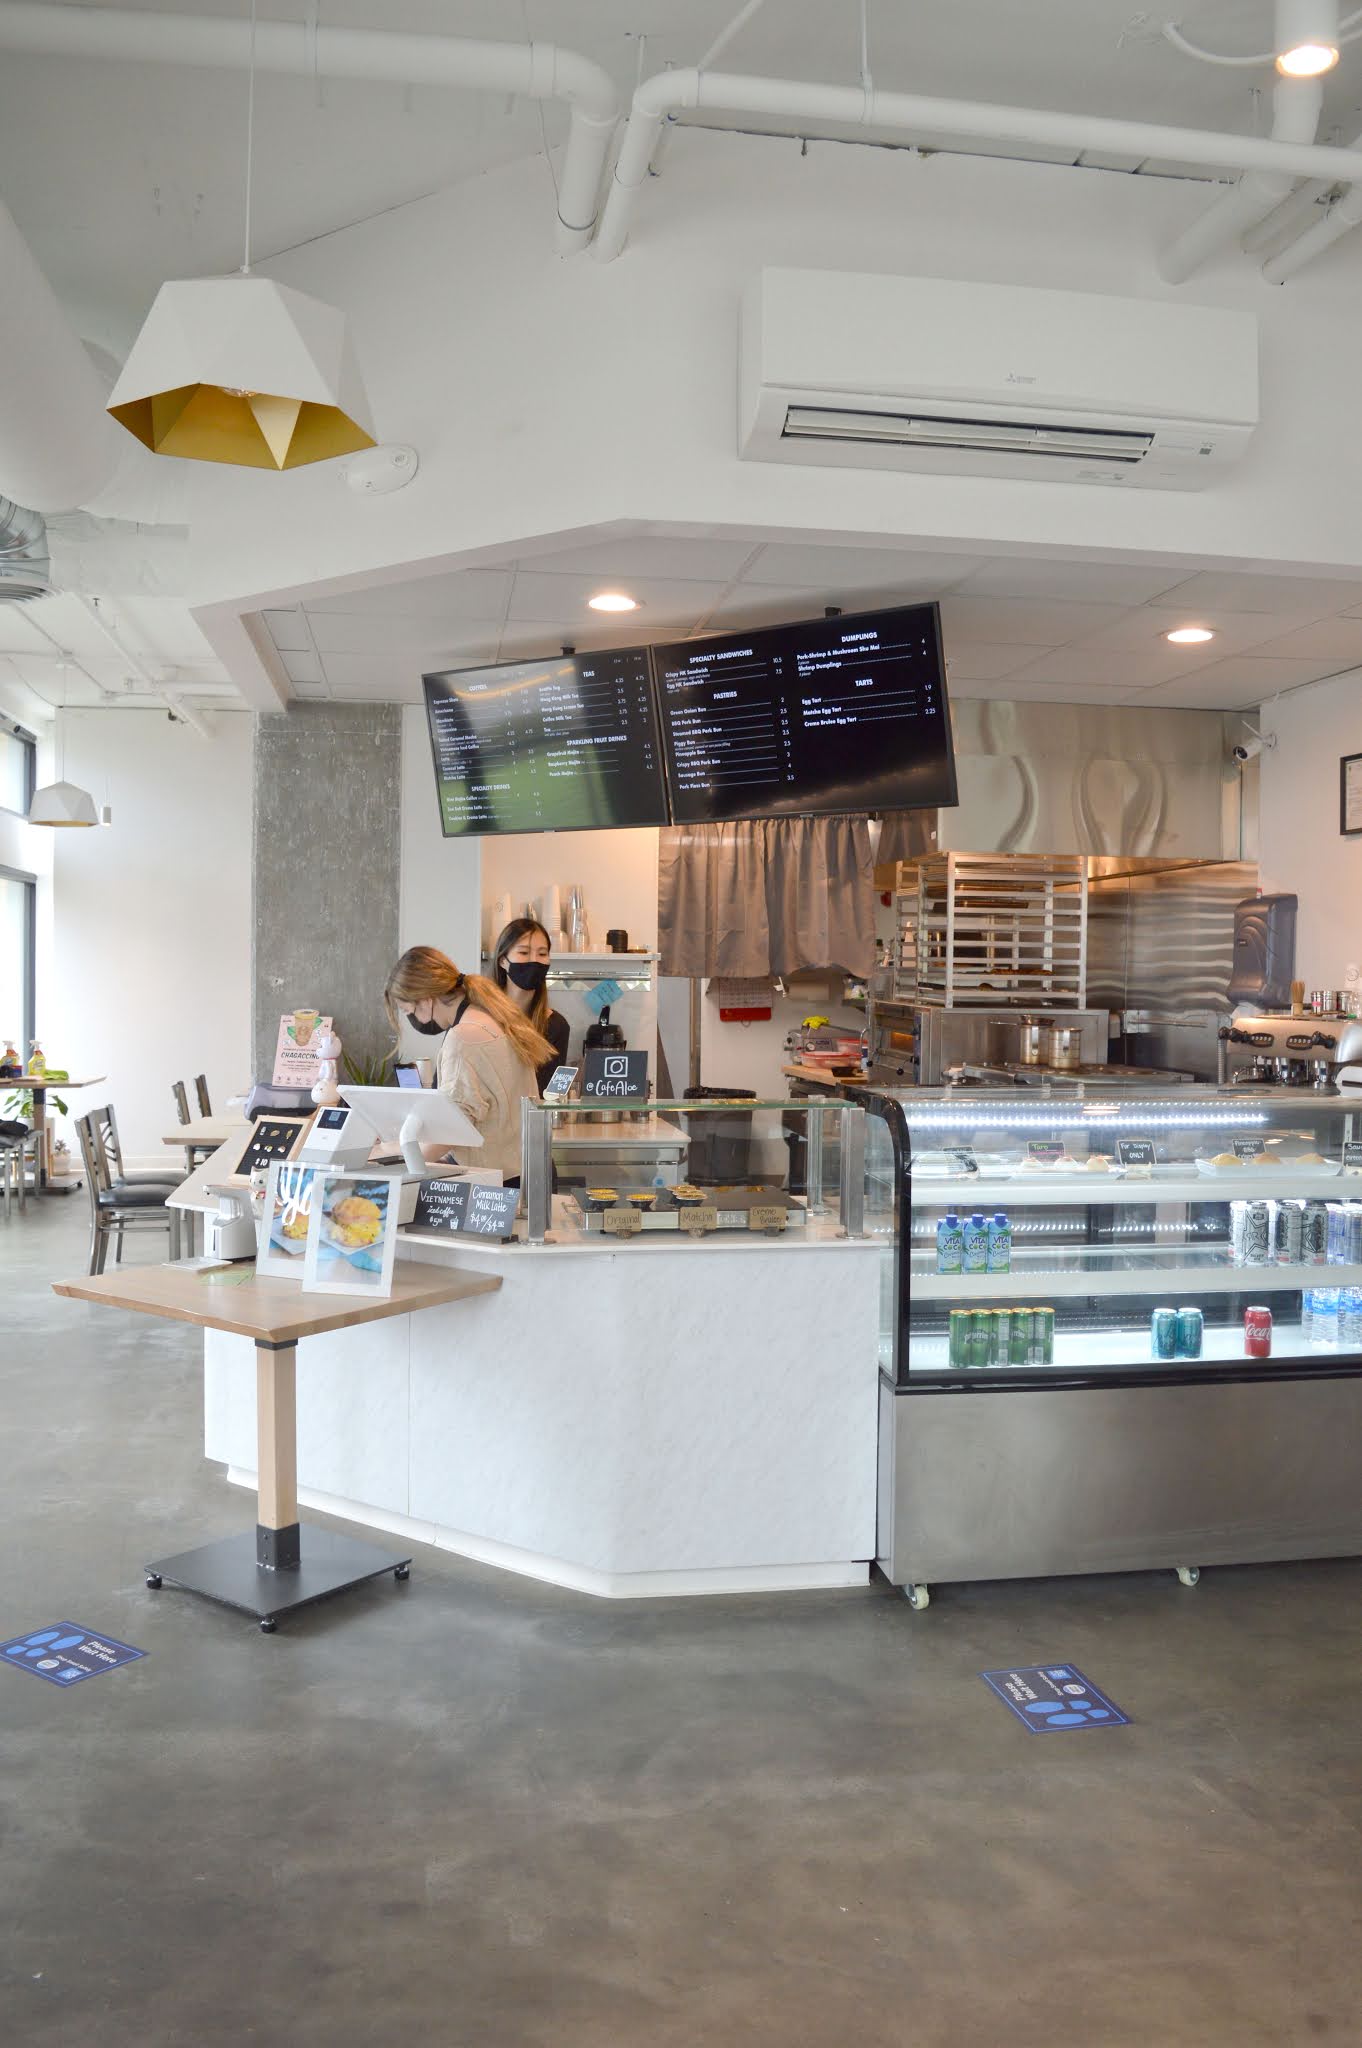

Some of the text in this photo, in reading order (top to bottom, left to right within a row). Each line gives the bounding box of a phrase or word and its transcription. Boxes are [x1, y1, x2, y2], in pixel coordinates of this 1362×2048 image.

[841, 631, 878, 643] DUMPLINGS
[689, 648, 753, 664] SPECIALTY SANDWICHES
[796, 651, 827, 660] Pork-Shrimp
[832, 647, 859, 656] Mushroom
[687, 667, 709, 675] Sandwich
[798, 664, 815, 672] Shrimp
[816, 661, 842, 670] Dumplings
[582, 670, 595, 678] TEAS
[683, 679, 705, 687] Sandwich
[855, 679, 873, 687] TARTS
[713, 690, 738, 700] PASTRIES
[836, 717, 847, 725] Egg
[566, 734, 627, 746] SPARKLING FRUIT DRINKS
[673, 740, 687, 748] Piggy
[675, 750, 697, 758] Pineapple
[430, 1181, 459, 1192] COCONUT
[420, 1190, 464, 1206] VIETNAMESE
[472, 1185, 503, 1201] Cinnamon
[426, 1205, 455, 1218] iced coffee
[475, 1200, 508, 1212] Milk Latte
[606, 1212, 640, 1226] Original
[683, 1210, 713, 1223] Matcha
[945, 1237, 960, 1245] VITA
[993, 1236, 1009, 1244] VITA
[78, 1644, 99, 1656] Wait
[95, 1652, 117, 1663] Here
[88, 1641, 116, 1655] Please
[1005, 1682, 1027, 1701] Please
[1009, 1673, 1039, 1700] Wait Here
